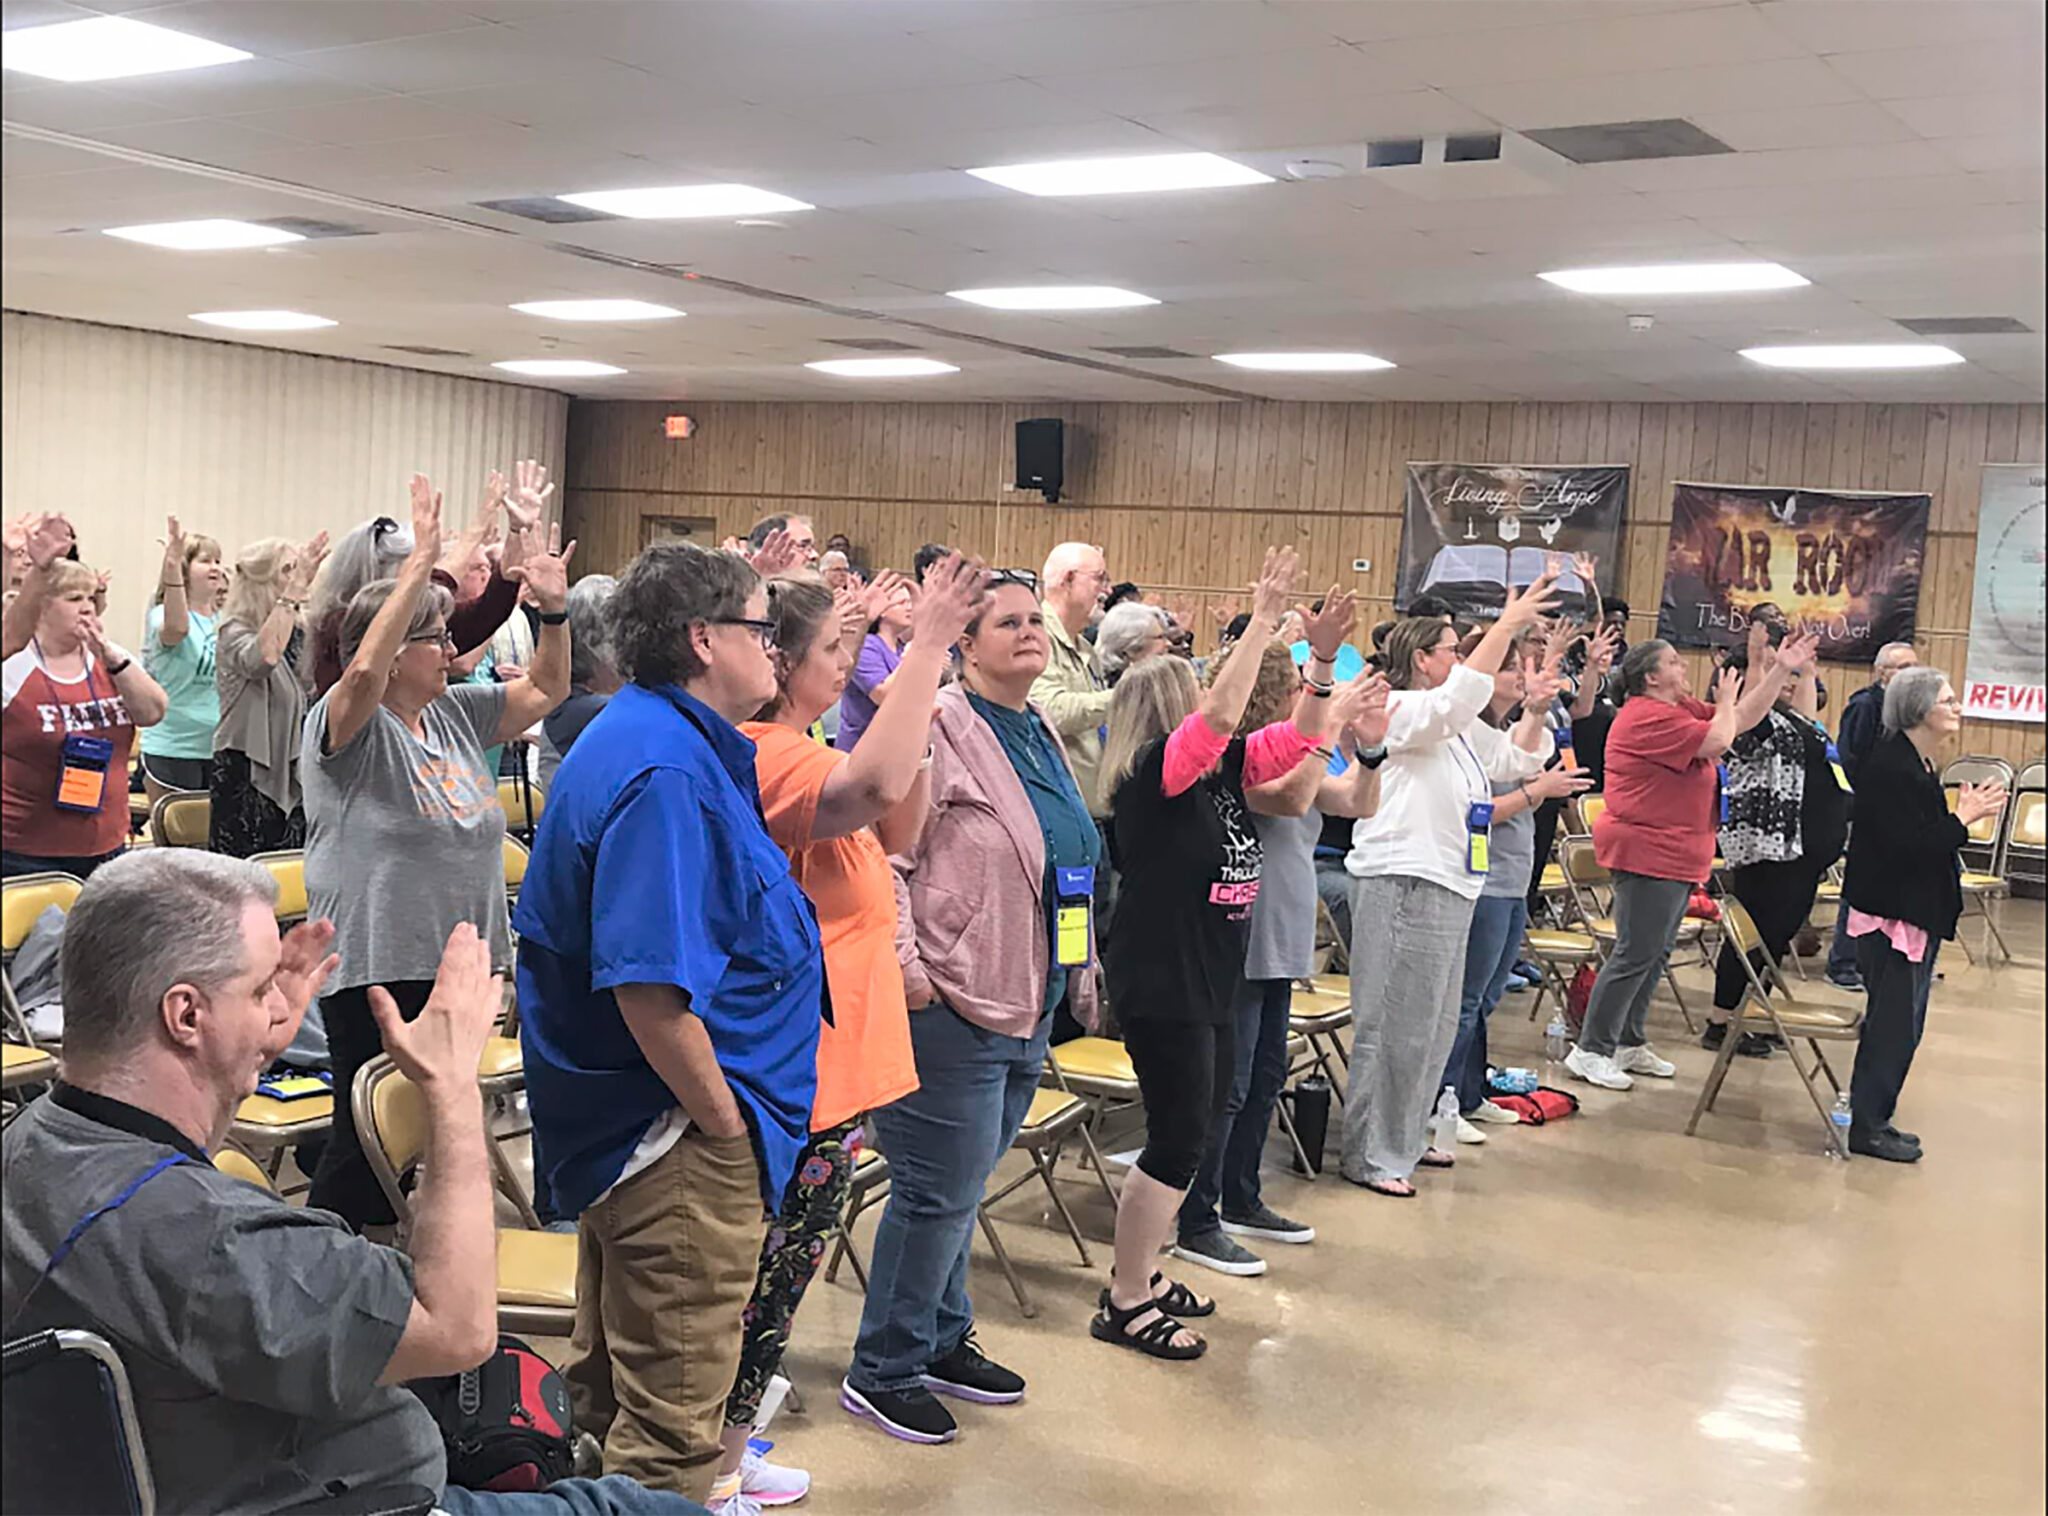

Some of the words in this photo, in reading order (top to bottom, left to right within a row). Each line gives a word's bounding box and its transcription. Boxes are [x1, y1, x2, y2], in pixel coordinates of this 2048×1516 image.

[1432, 475, 1516, 515] Living
[1518, 478, 1602, 518] Hope
[1696, 602, 1727, 629] The
